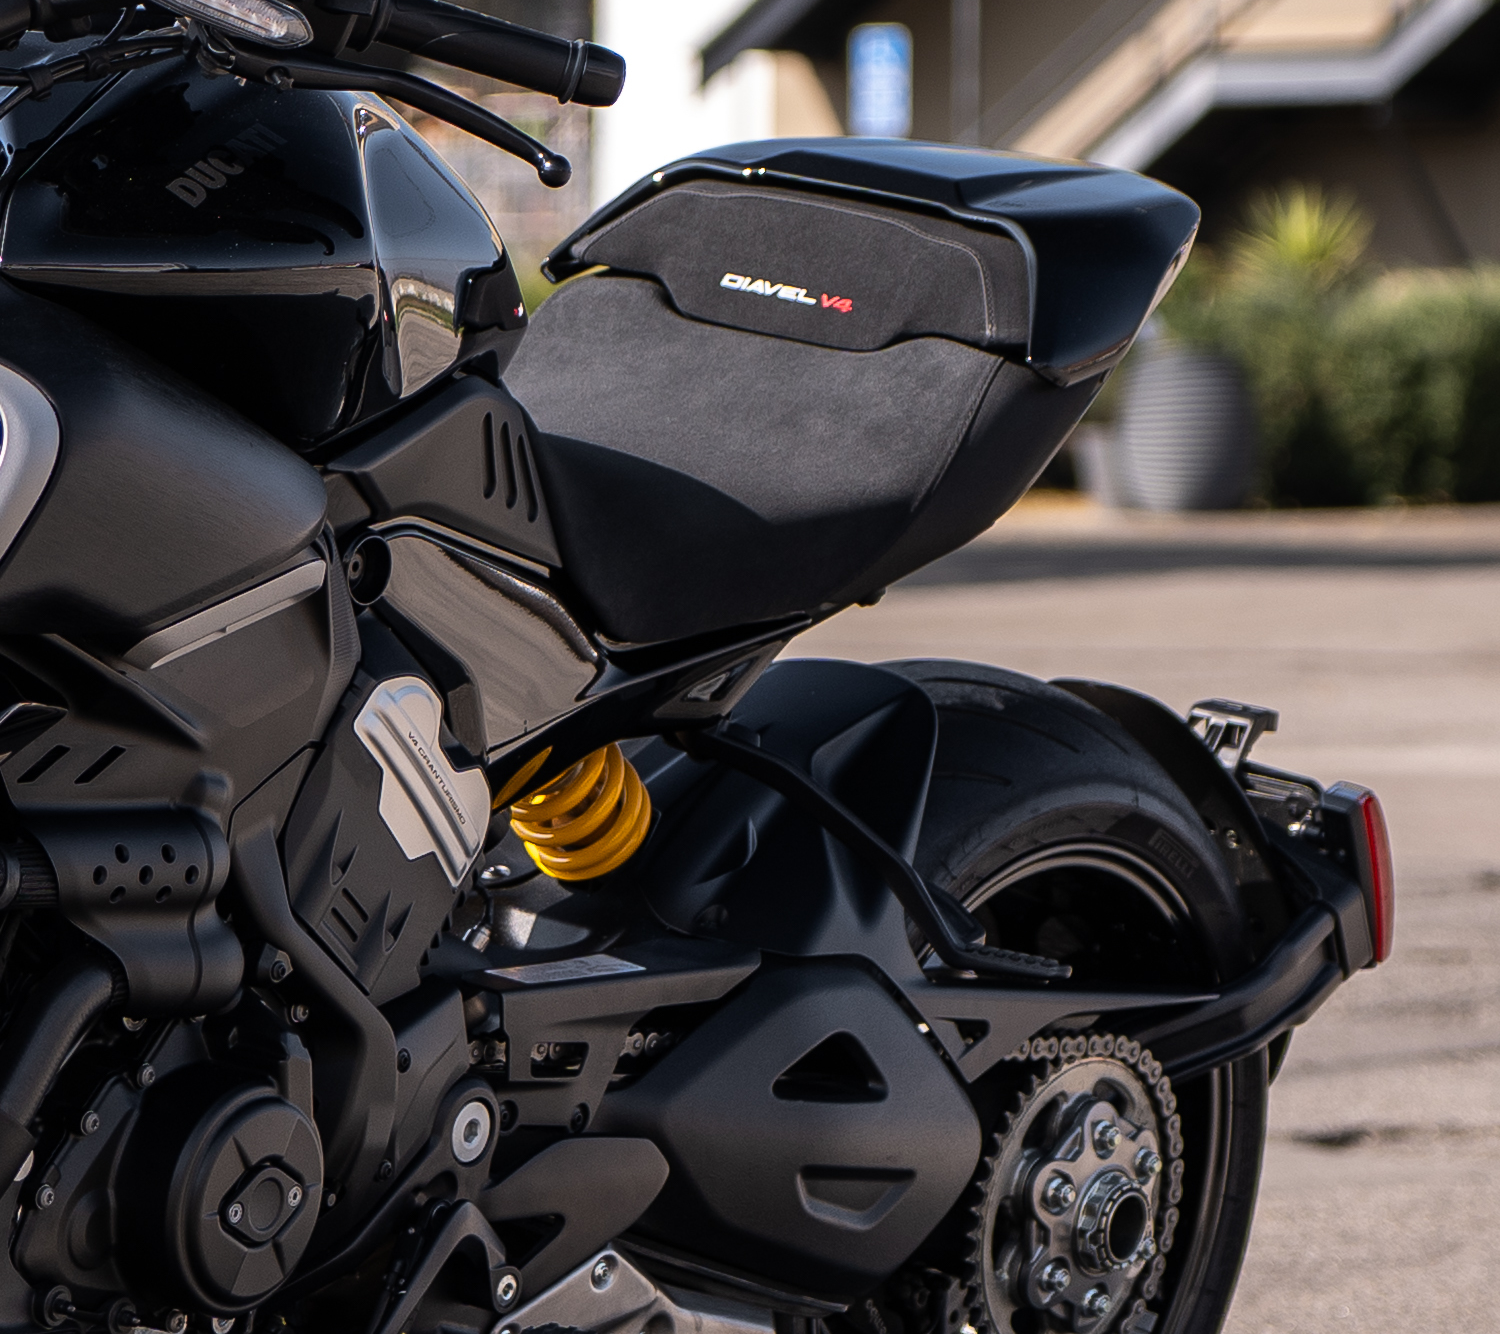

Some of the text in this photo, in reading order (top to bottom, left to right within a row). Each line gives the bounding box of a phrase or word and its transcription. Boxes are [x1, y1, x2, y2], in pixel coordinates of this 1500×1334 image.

[165, 123, 288, 208] DUCATI
[719, 272, 853, 313] DIAVEL V4
[408, 731, 467, 825] V4 GRANTURISMO
[1148, 827, 1201, 879] PIRELLI
